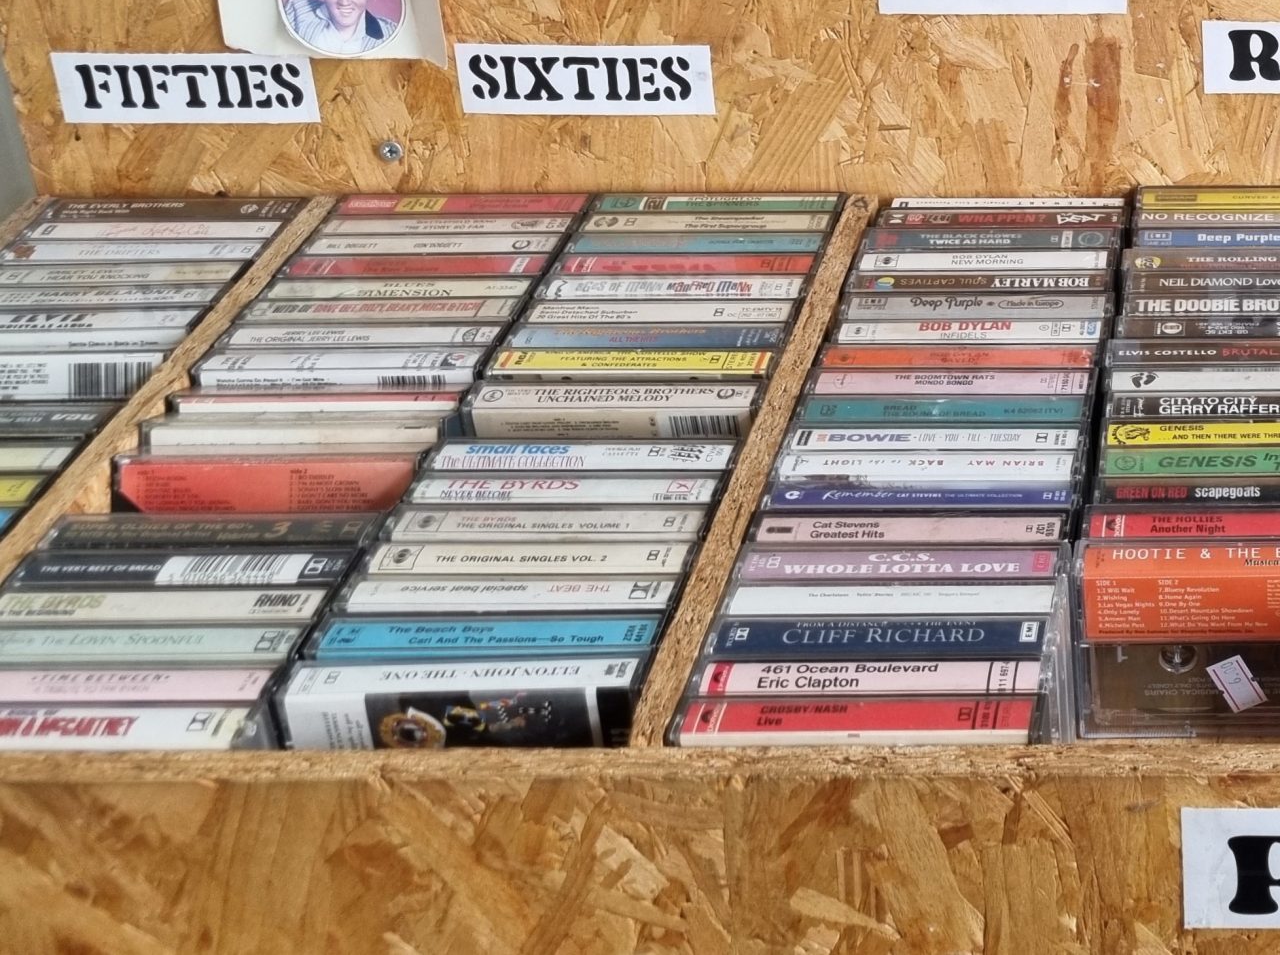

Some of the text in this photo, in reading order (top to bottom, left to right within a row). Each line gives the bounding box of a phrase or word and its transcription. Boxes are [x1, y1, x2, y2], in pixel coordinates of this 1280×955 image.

[469, 53, 693, 102] SIXTIES
[75, 63, 303, 110] FIFTIES
[1141, 213, 1168, 221] NO
[1174, 213, 1271, 222] RECOGNIZE
[1198, 233, 1231, 243] Deep
[1236, 233, 1280, 243] Purple
[991, 276, 1089, 288] BOB MARLEY
[1159, 278, 1188, 286] NEIL
[1191, 277, 1252, 286] DIAMOND
[910, 297, 983, 310] Deep Purple
[1136, 299, 1172, 312] THE
[1175, 299, 1240, 312] DOOBIE
[919, 322, 1012, 332] BOB DYLAN
[535, 388, 564, 396] THE
[566, 388, 641, 396] RIGHTEOUS
[1159, 404, 1215, 414] GERRY
[1158, 456, 1257, 468] GENESIS
[1195, 485, 1261, 499] scapegoats
[813, 521, 880, 529] Cat Stevens
[1150, 524, 1226, 534] Another Night
[810, 530, 884, 540] Greatest Hits
[869, 552, 934, 562] C.C.S.
[1113, 549, 1186, 560] HOOTIE
[1200, 549, 1212, 559] &
[1228, 548, 1260, 558] THE
[784, 562, 1020, 575] WHOLE LOTTA LOVE
[782, 628, 985, 644] CLIFF RICHARD
[761, 663, 938, 674] 461 Ocean Boulevard
[757, 676, 859, 690] Eric Clapton
[757, 716, 783, 726] Live
